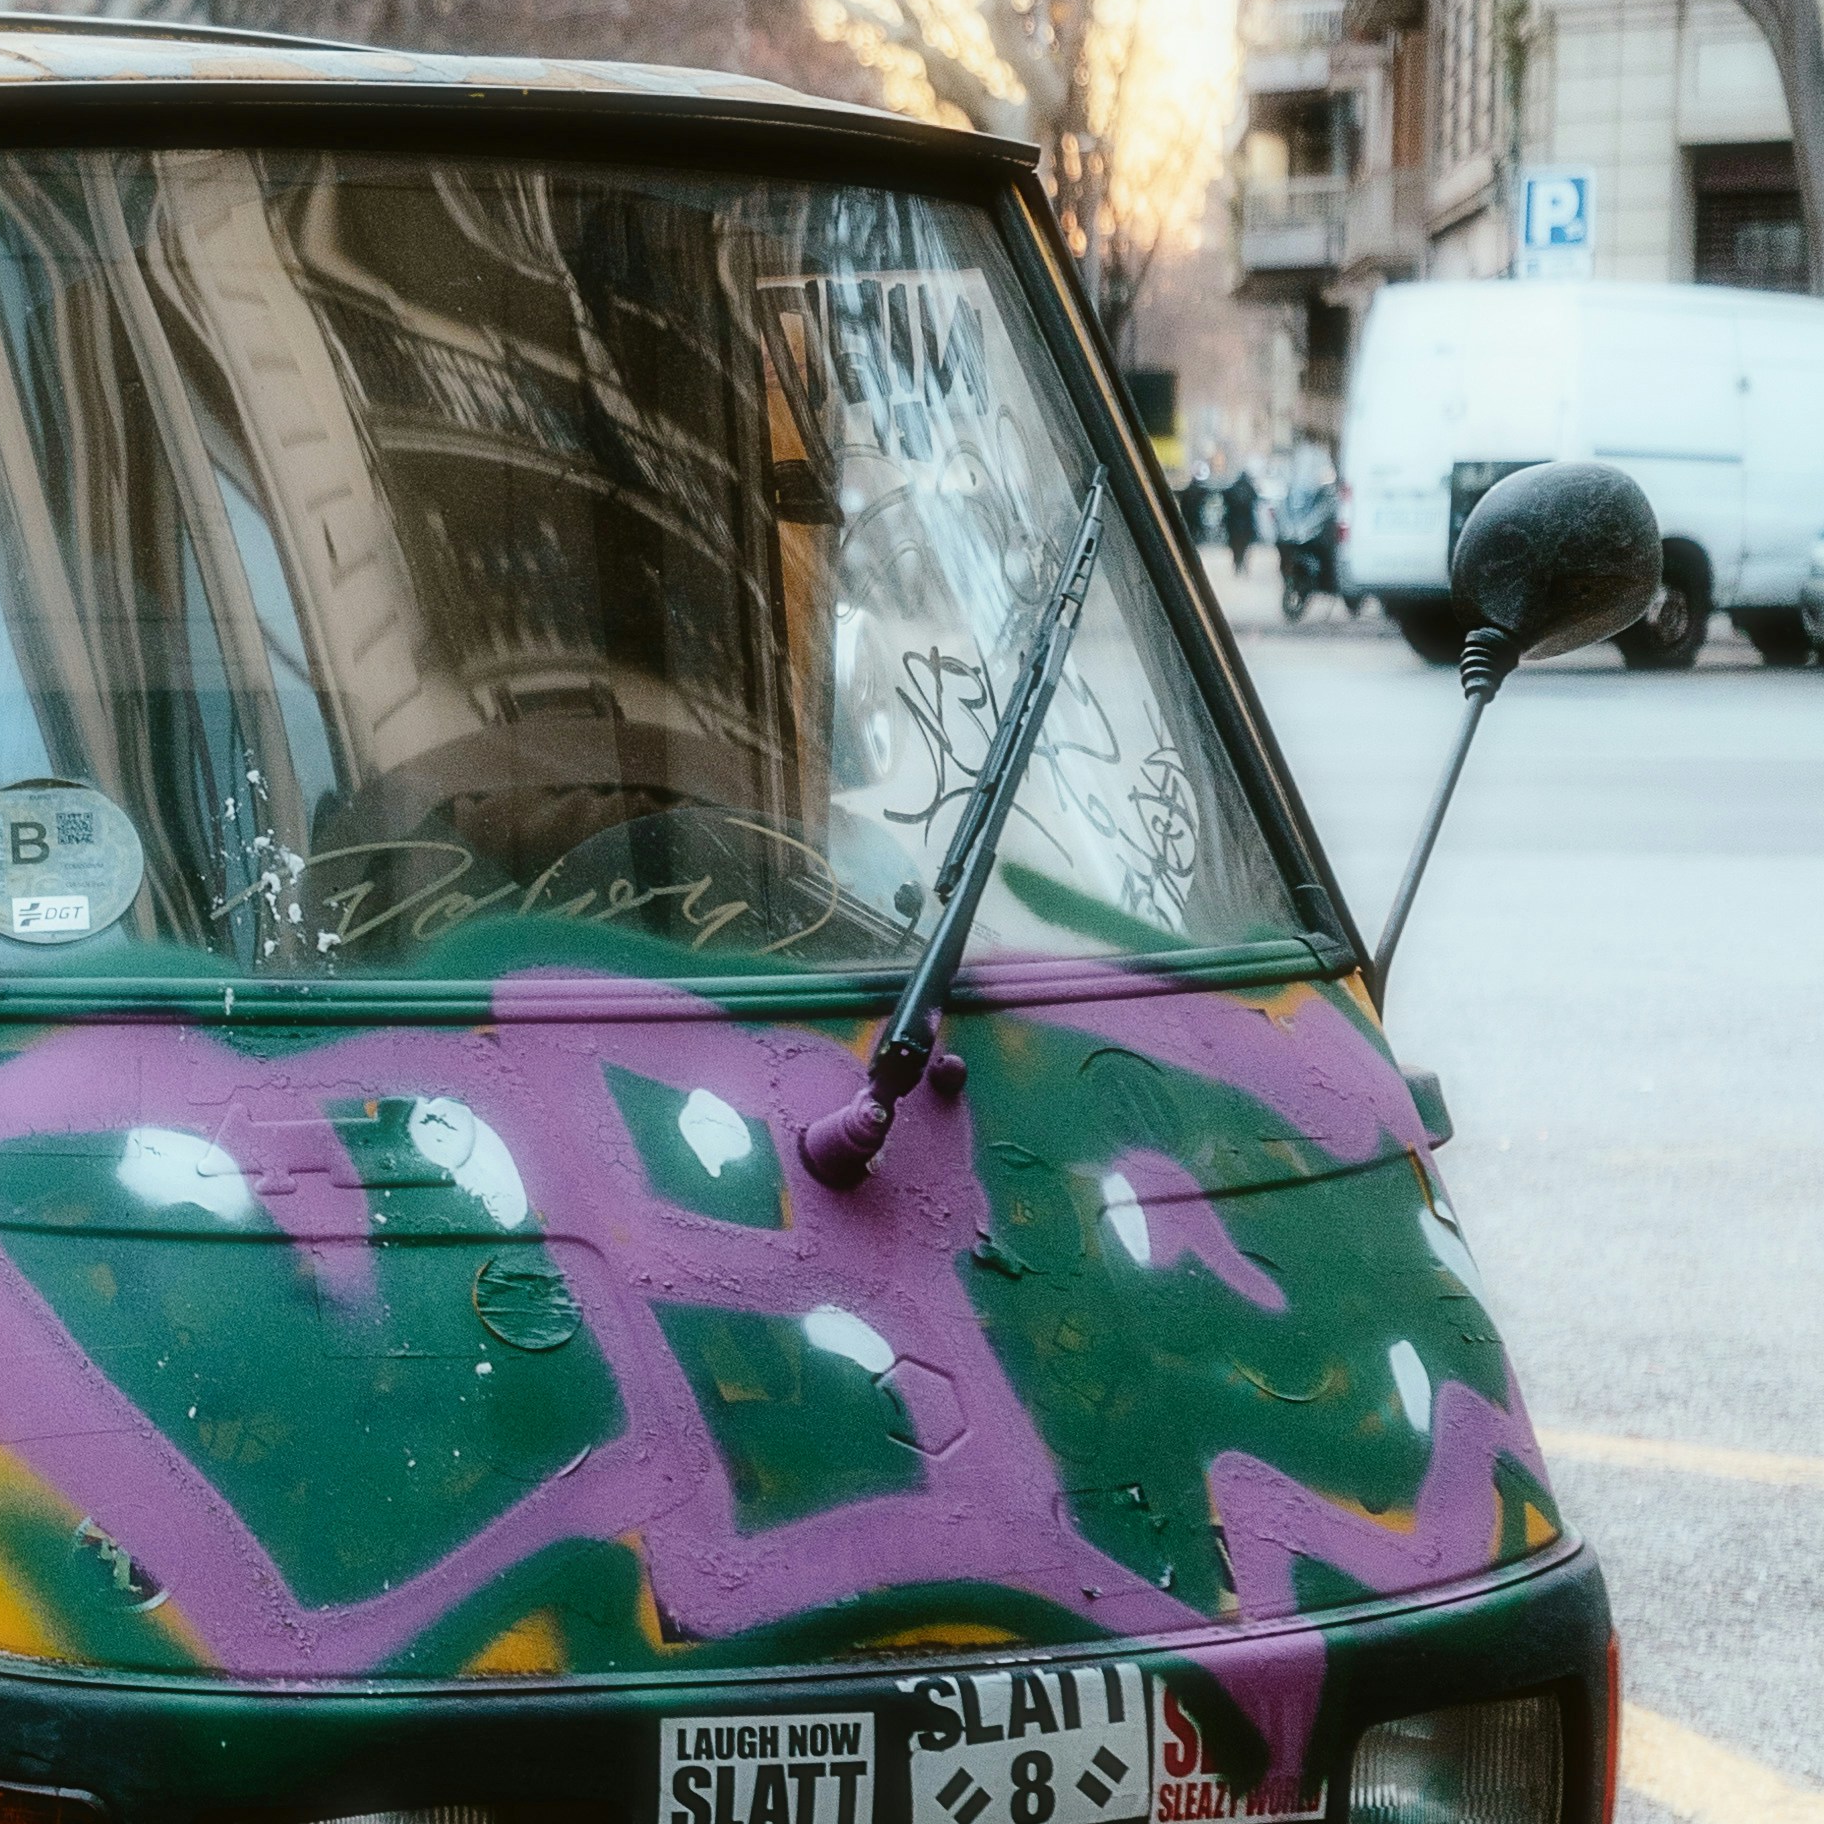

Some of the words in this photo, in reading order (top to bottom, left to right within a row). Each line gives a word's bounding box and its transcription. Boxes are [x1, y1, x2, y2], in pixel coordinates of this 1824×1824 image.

[1532, 181, 1579, 246] P
[10, 821, 51, 865] B
[44, 906, 84, 920] DGT
[676, 1725, 780, 1761] LAUGH
[787, 1722, 862, 1758] NOW
